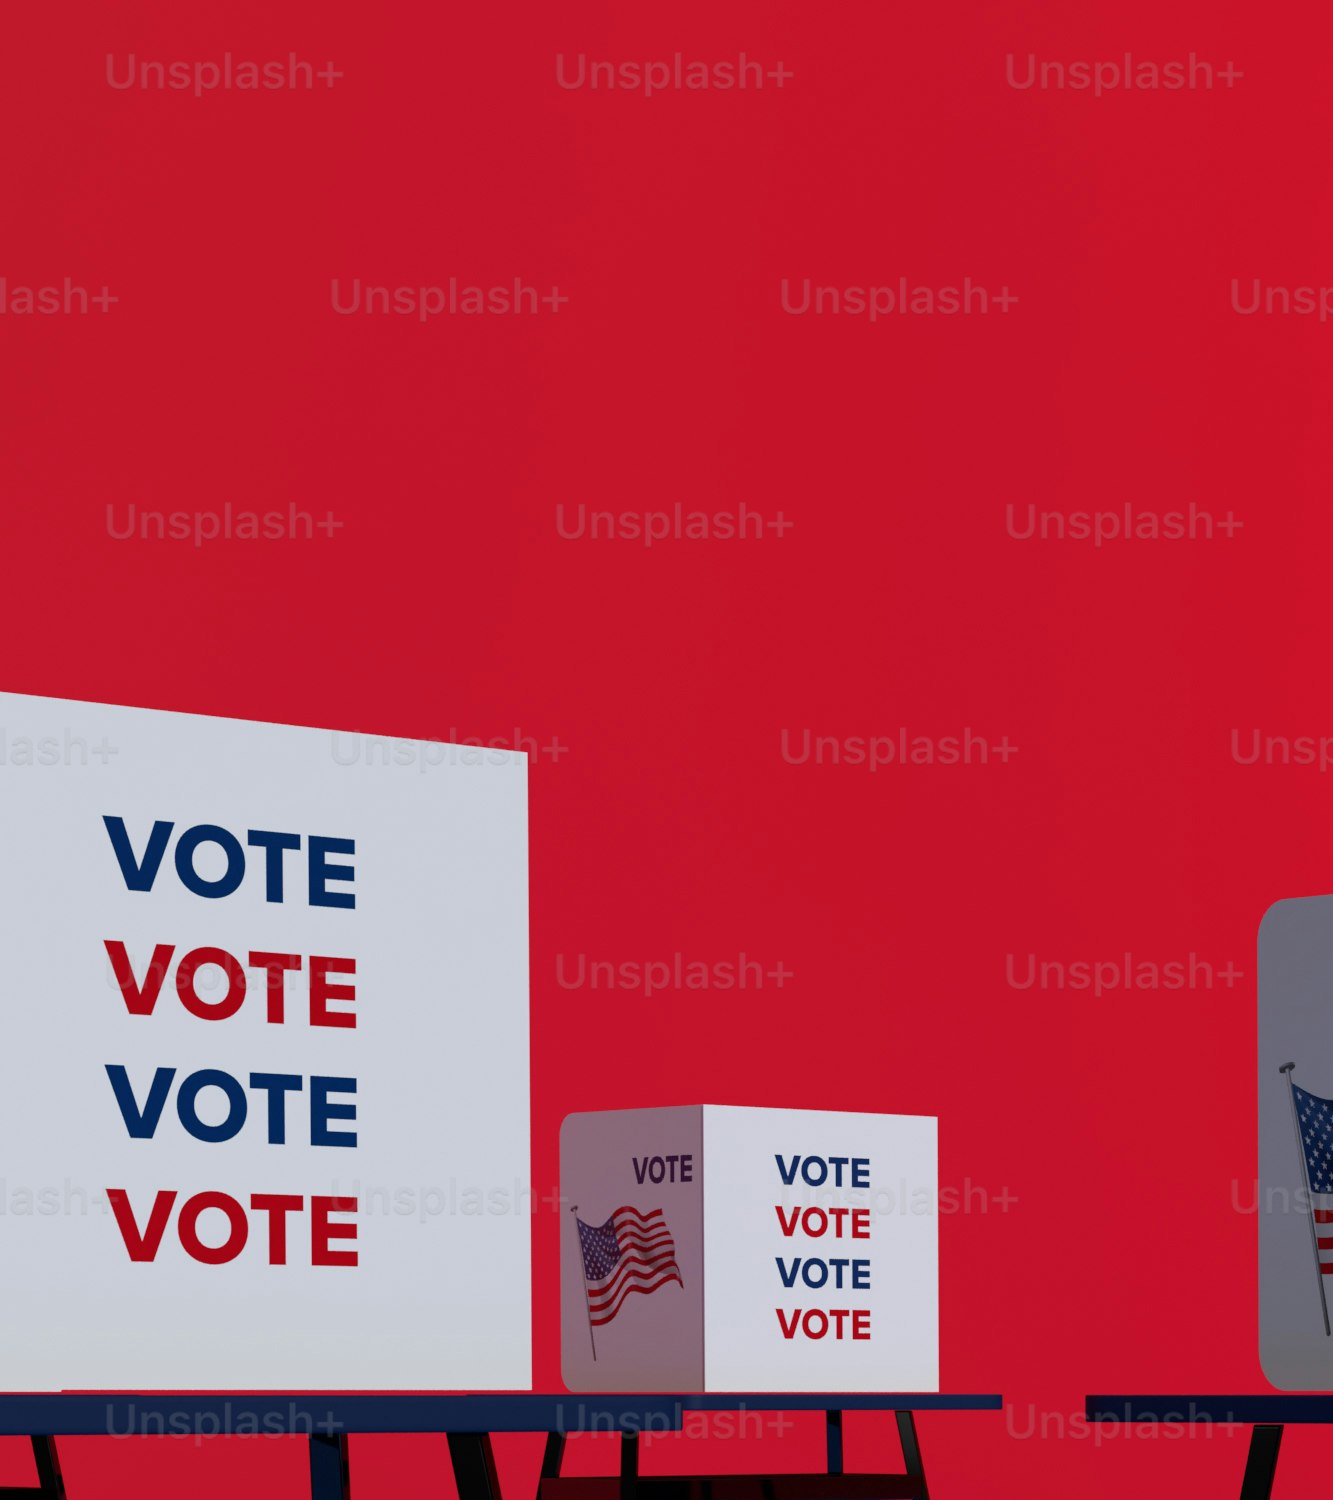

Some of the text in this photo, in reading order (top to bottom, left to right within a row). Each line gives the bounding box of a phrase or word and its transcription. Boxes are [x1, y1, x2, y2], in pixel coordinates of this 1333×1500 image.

[103, 816, 355, 909] VOTE
[104, 940, 356, 1028] VOTE
[105, 1065, 357, 1147] VOTE
[632, 1155, 692, 1184] VOTE
[775, 1155, 869, 1188] VOTE
[106, 1189, 358, 1266] VOTE
[775, 1206, 870, 1238] VOTE
[776, 1258, 870, 1289] VOTE
[776, 1309, 870, 1340] VOTE
